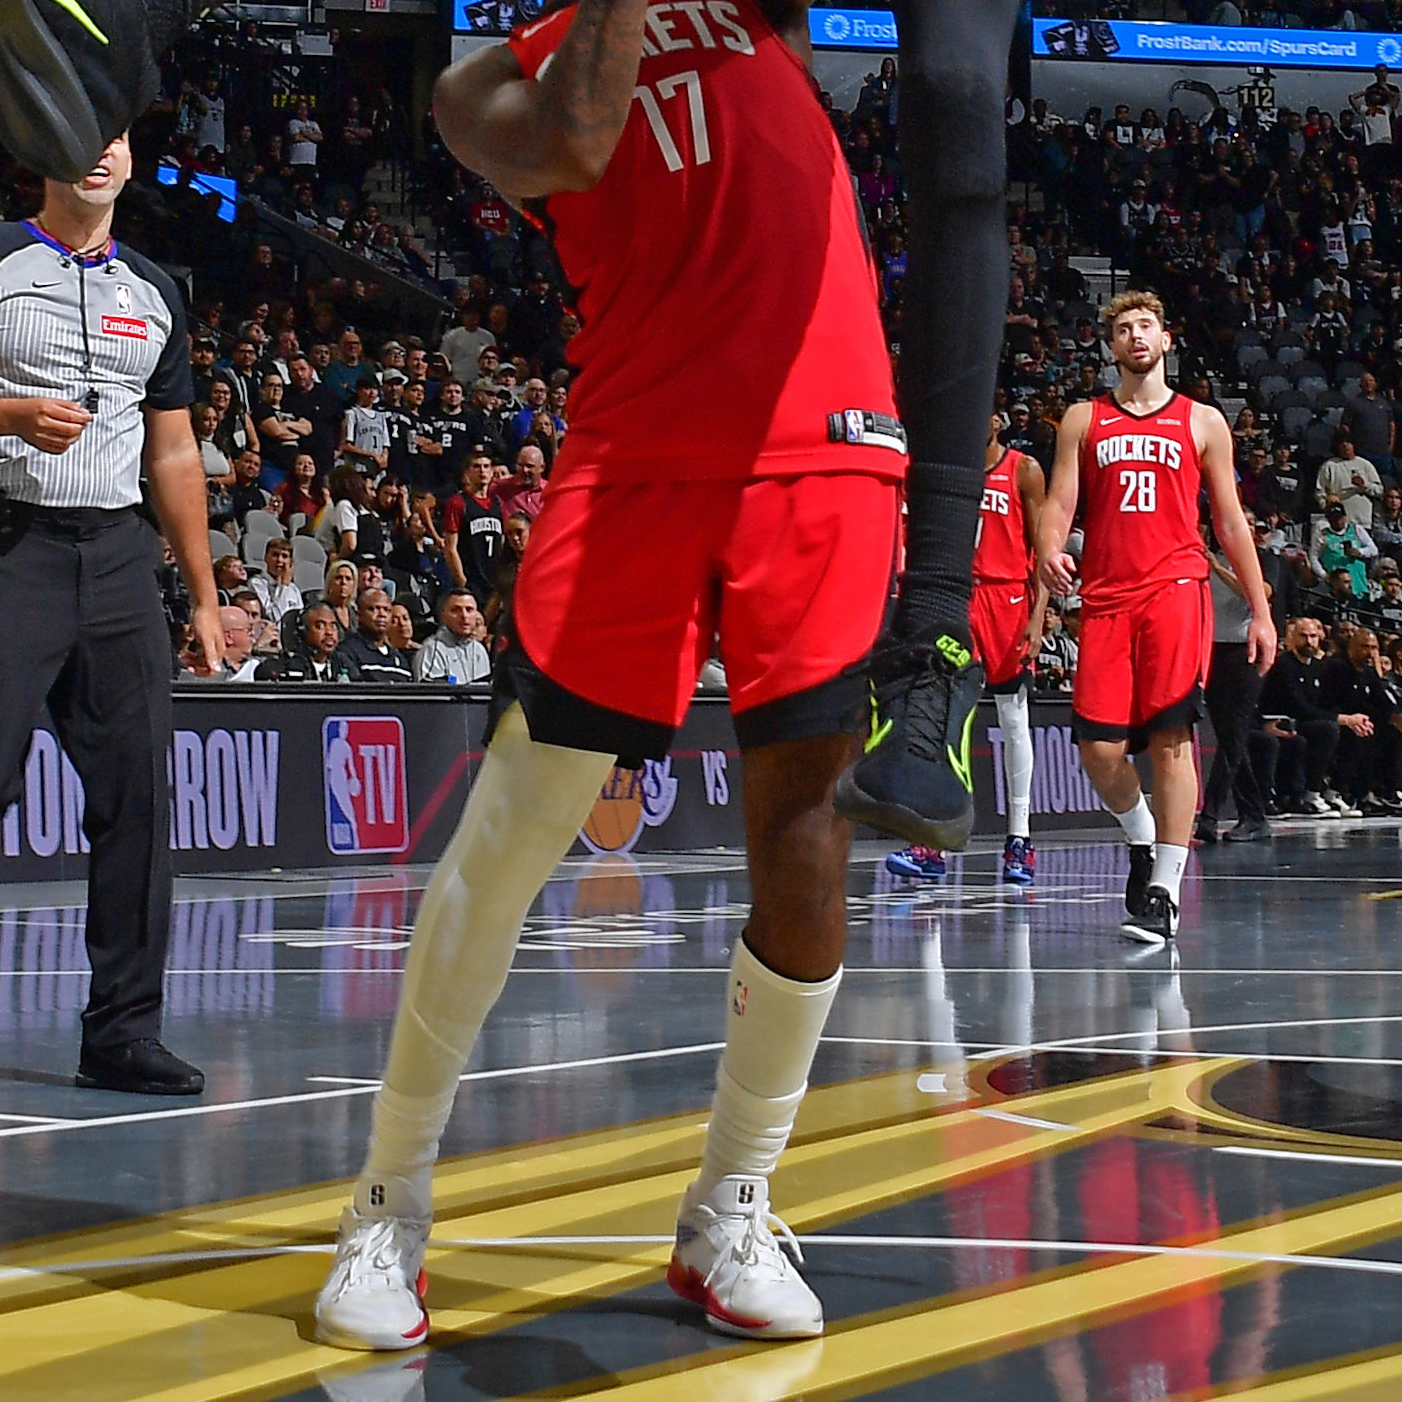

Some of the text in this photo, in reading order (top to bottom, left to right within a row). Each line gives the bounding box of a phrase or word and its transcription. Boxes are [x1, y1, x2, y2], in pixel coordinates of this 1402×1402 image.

[853, 18, 899, 41] Frost
[1137, 33, 1357, 57] FrostBank.com/SpursCard
[1240, 88, 1275, 108] 112
[633, 70, 710, 172] 17
[103, 319, 147, 335] Emirates
[1096, 435, 1182, 470] ROCKETS
[980, 488, 1009, 515] ETS
[1119, 470, 1156, 512] 28
[358, 744, 396, 824] TV
[701, 750, 729, 806] VS
